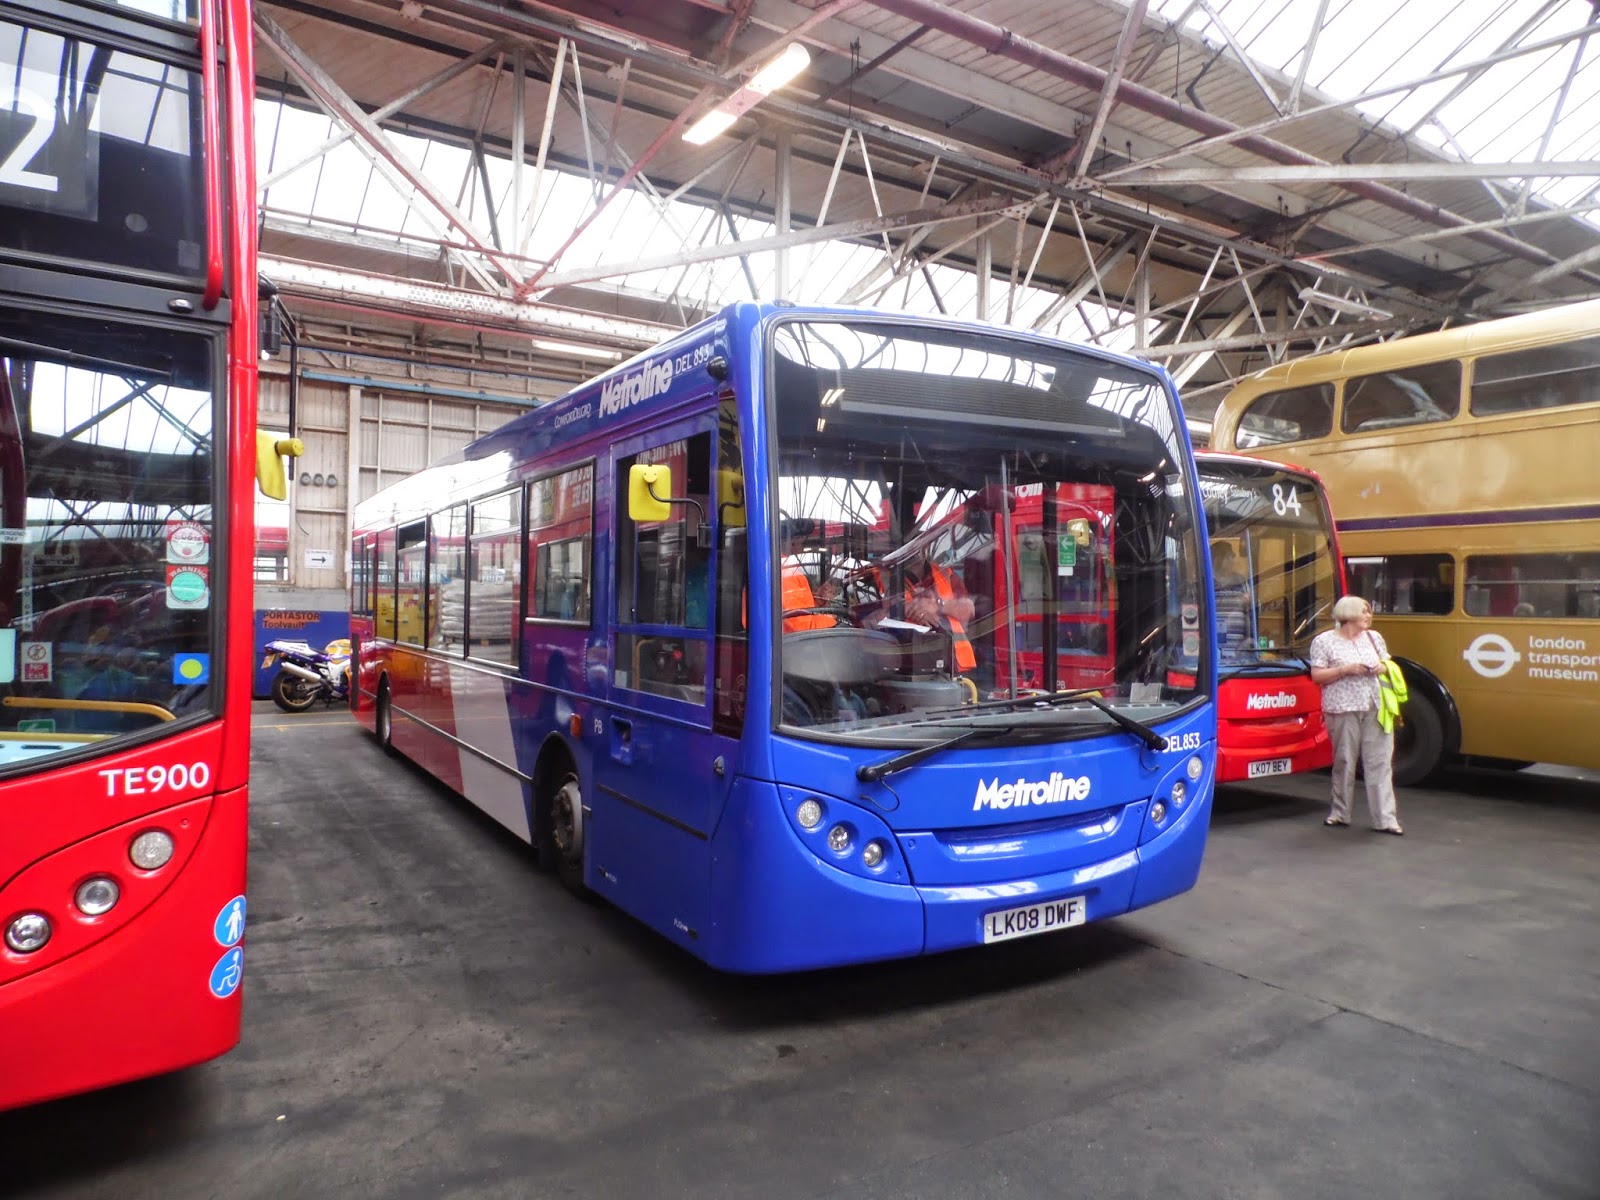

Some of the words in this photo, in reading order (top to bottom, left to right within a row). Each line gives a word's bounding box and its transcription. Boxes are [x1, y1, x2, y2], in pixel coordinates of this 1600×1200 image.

[0, 88, 59, 192] 2
[598, 358, 673, 418] Metroline
[675, 353, 692, 375] DEL
[693, 343, 710, 366] 853
[1272, 483, 1302, 517] 84
[169, 566, 208, 580] WARNING
[263, 610, 320, 621] PORTASTOR
[263, 620, 306, 630] Toolvault
[1529, 636, 1586, 650] london
[1528, 667, 1598, 681] museum
[1247, 691, 1297, 711] Metroline
[594, 718, 603, 734] PB
[1162, 732, 1200, 753] DEL853
[1251, 761, 1271, 775] LK07
[1272, 760, 1288, 772] BEY
[98, 762, 210, 796] TE900
[973, 772, 1091, 811] Metroline
[992, 908, 1039, 936] LK08
[1045, 901, 1078, 926] DWF
